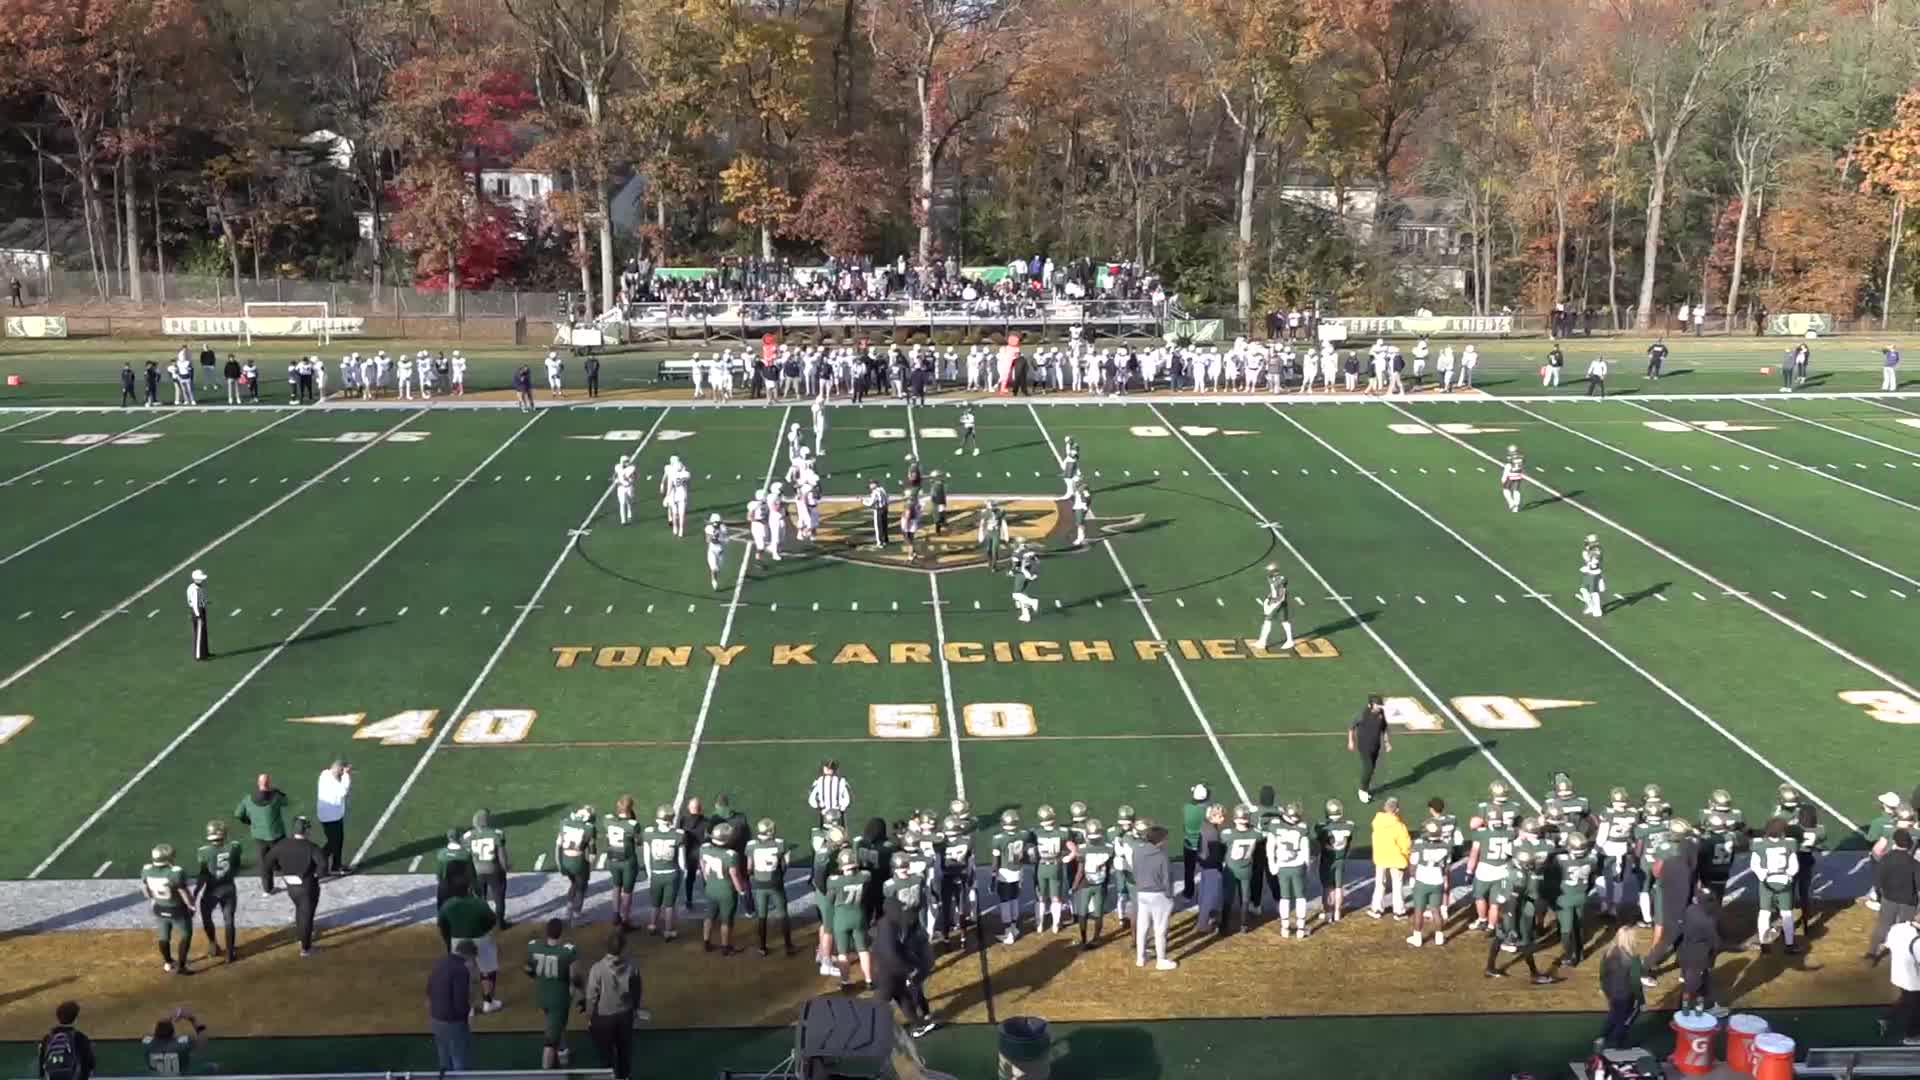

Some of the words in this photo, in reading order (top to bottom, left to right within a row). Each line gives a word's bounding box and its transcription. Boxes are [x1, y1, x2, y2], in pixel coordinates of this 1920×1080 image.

[551, 645, 748, 668] TONY
[771, 641, 1116, 665] KARCICH
[1131, 640, 1341, 661] FIELD
[352, 709, 538, 745] 40
[868, 703, 1037, 738] 50
[471, 837, 495, 861] 42
[533, 953, 558, 977] 70
[1692, 1038, 1707, 1053] G
